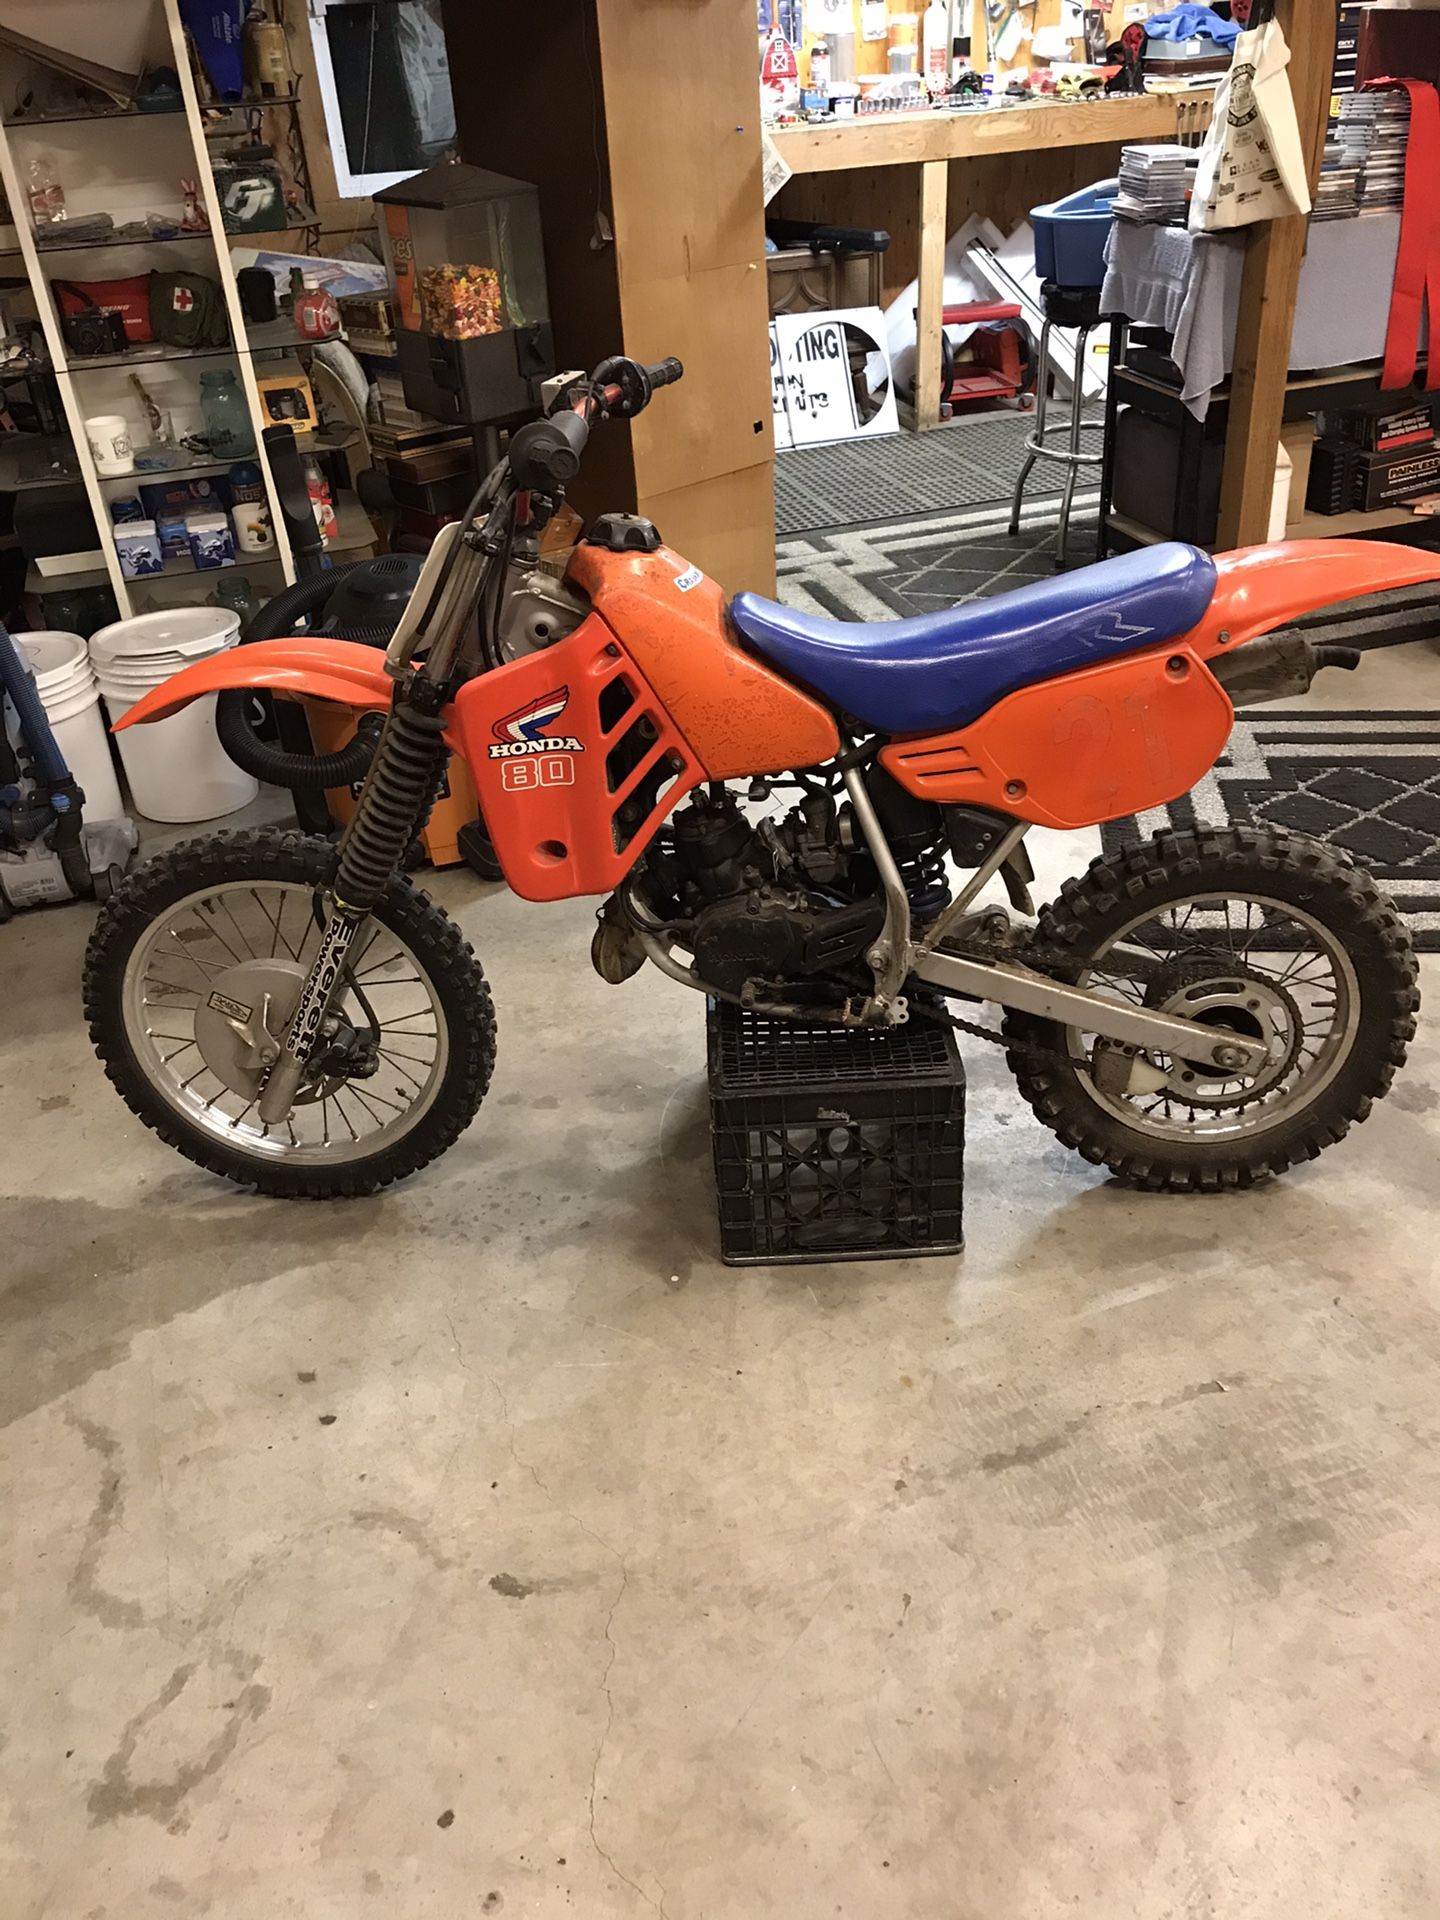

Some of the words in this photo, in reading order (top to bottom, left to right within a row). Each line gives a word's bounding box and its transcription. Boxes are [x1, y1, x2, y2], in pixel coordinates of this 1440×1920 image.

[1389, 458, 1440, 479] PAINLESS
[488, 737, 585, 758] HONDA
[501, 754, 575, 792] 80
[285, 916, 343, 1052] Powersports
[293, 916, 360, 1064] Everett
